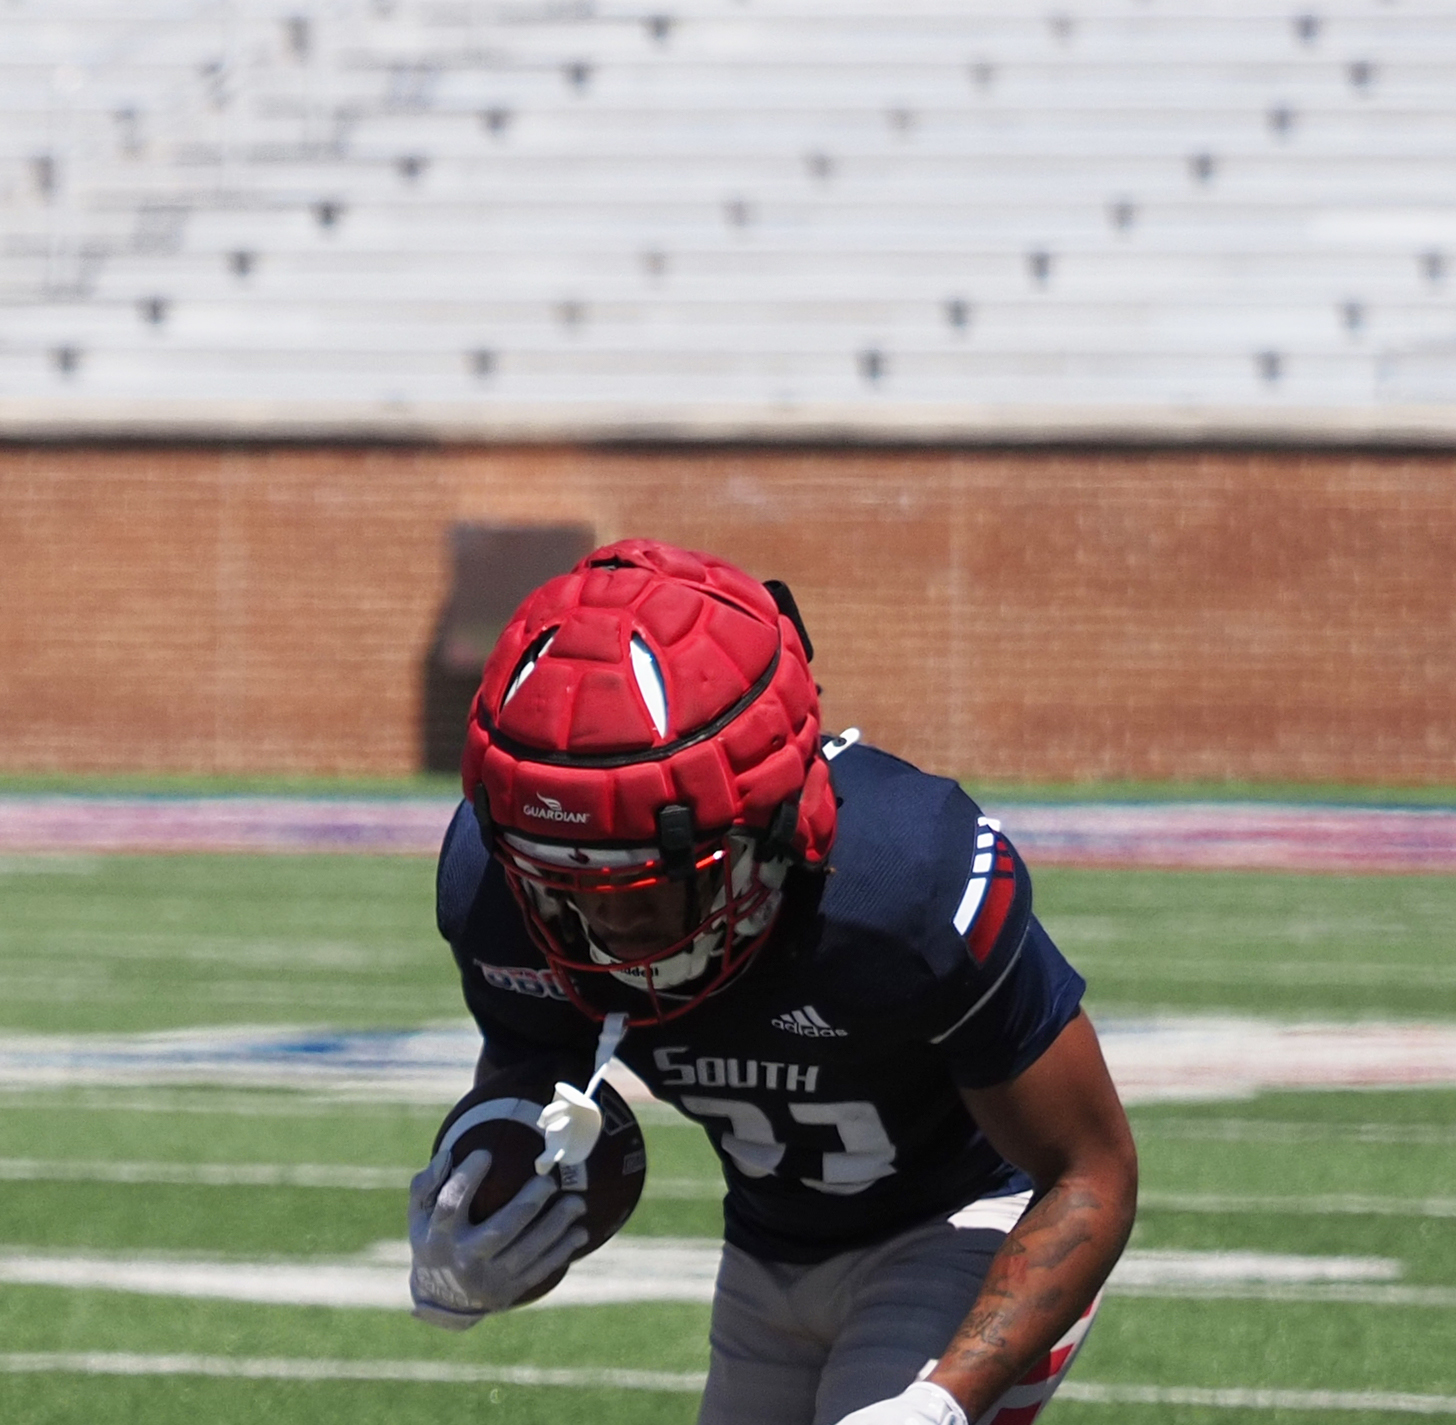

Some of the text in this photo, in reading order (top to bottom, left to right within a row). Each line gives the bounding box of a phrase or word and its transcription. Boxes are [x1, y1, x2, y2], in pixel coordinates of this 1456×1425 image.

[522, 803, 588, 825] GUARDIAN
[770, 1015, 849, 1038] adidas
[652, 1045, 821, 1094] SOUTH
